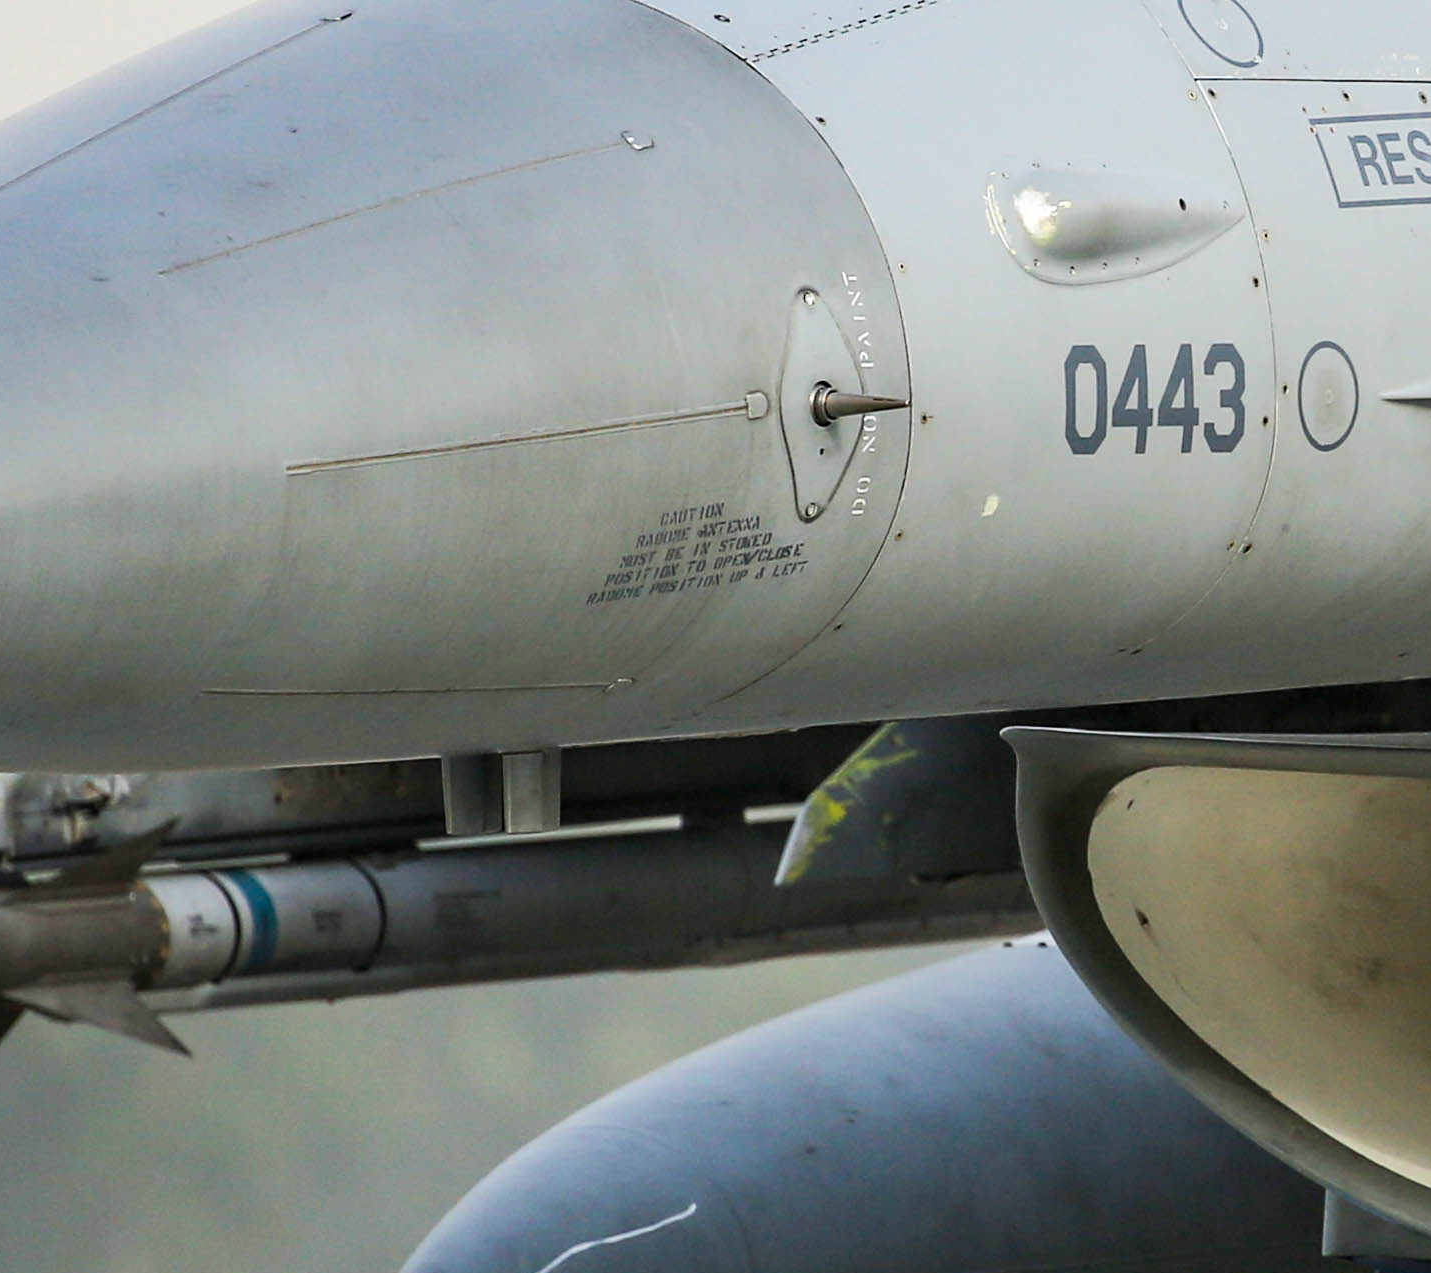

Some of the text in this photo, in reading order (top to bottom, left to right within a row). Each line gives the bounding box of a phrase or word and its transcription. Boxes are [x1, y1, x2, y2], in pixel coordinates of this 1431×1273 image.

[841, 271, 878, 517] DO NO PAINT
[1063, 343, 1246, 456] 0443
[635, 516, 761, 549] RADOME ANTENNA
[660, 502, 726, 527] CAUTION
[603, 542, 805, 587] POSITION TO OPEN/CLOSE
[664, 546, 685, 562] BE
[693, 542, 711, 557] IN
[585, 585, 643, 605] RADOME
[648, 574, 721, 595] POSITION
[729, 569, 749, 584] UP
[771, 560, 809, 578] LEFT
